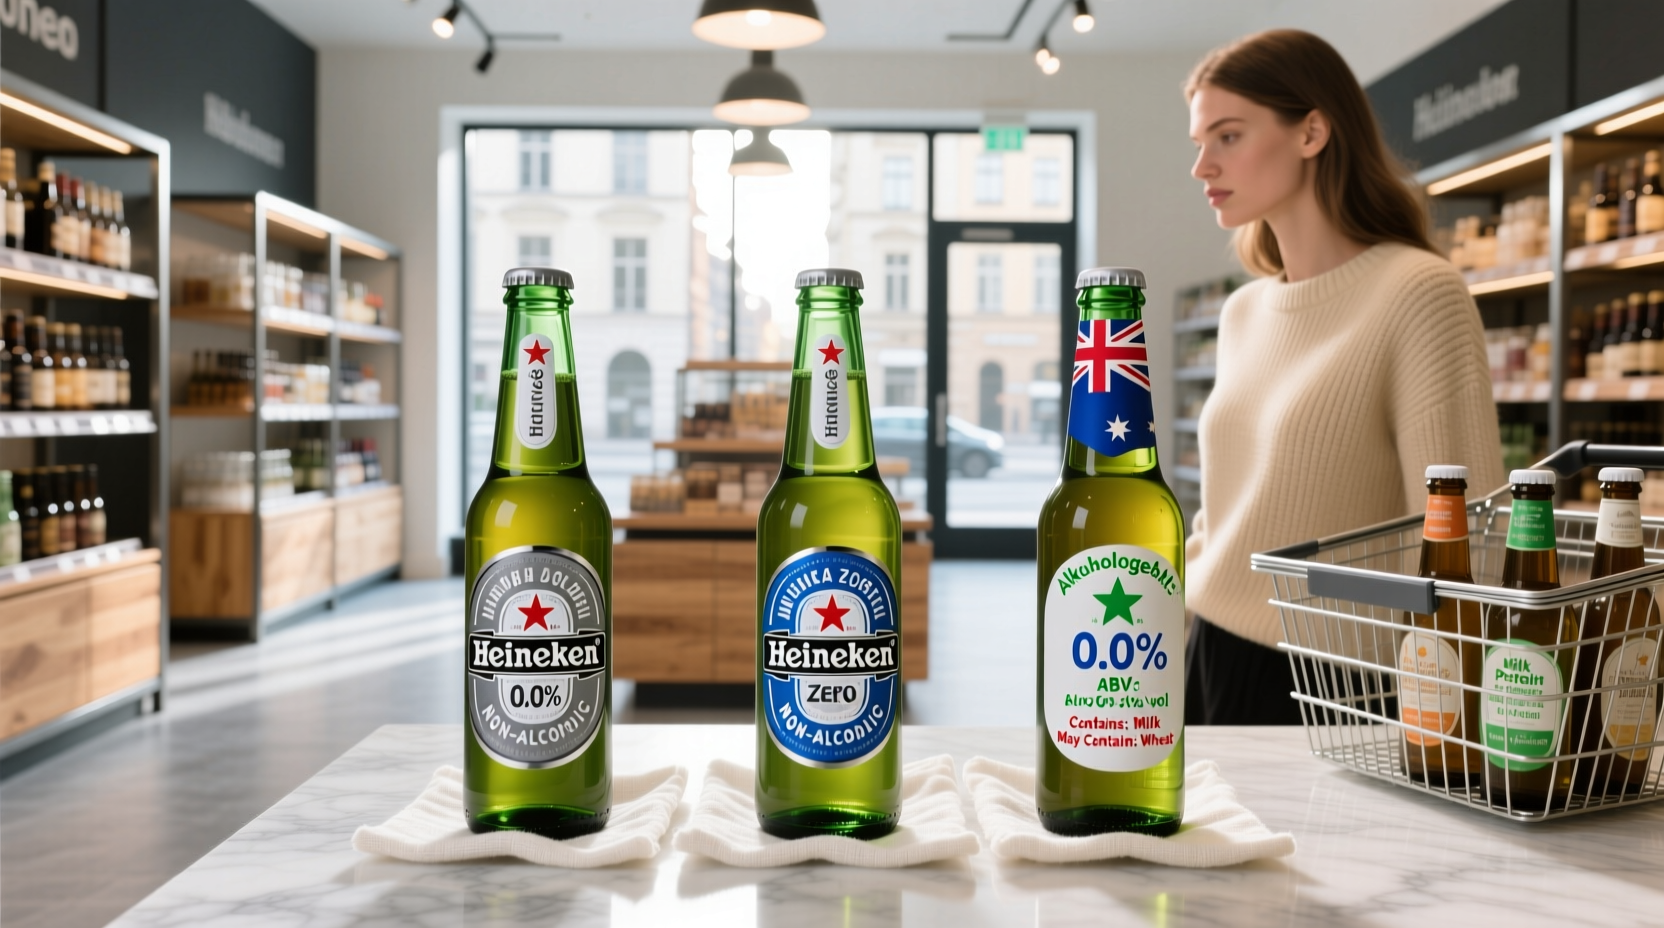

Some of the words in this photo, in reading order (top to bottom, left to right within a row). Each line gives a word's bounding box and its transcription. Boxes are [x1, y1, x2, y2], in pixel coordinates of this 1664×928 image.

[1072, 631, 1168, 671] 0.0%
[1503, 656, 1532, 673] Milk
[510, 684, 562, 708] 0.0%
[1133, 715, 1161, 730] Milk
[1057, 730, 1081, 748] May
[1140, 732, 1175, 747] Wheat
